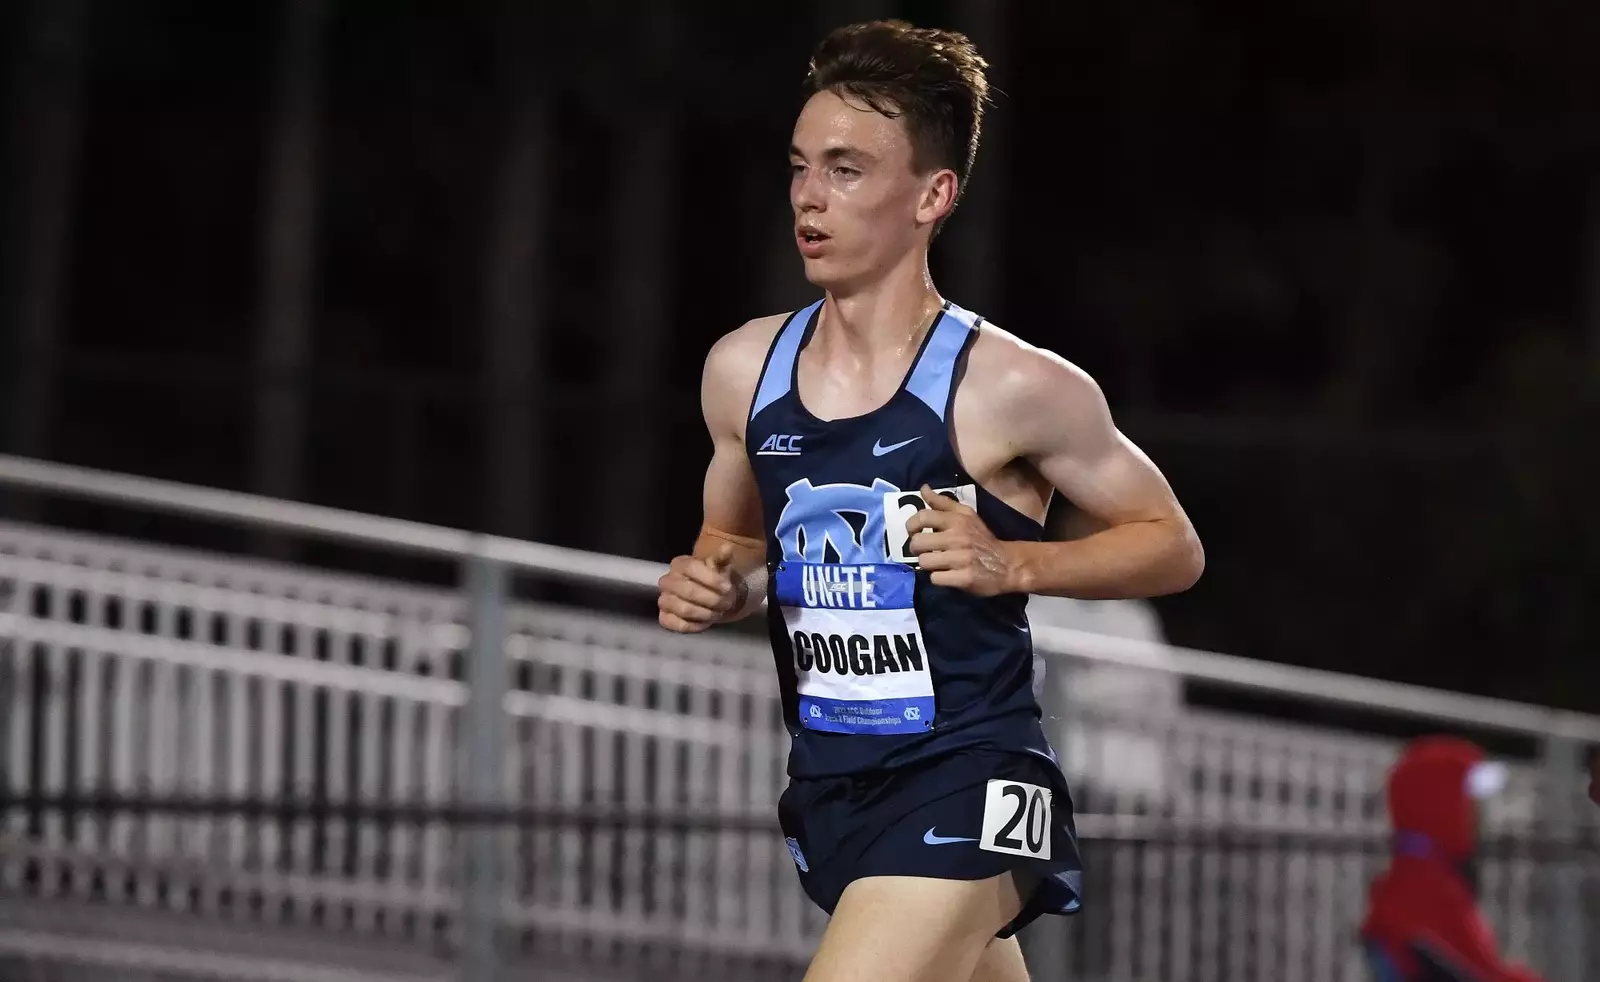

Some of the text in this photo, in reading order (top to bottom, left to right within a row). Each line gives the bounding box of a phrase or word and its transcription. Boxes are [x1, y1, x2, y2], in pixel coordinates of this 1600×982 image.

[759, 433, 804, 452] ACC
[802, 564, 876, 608] UNITE
[793, 630, 924, 676] COOGAN
[843, 714, 857, 725] Field
[857, 717, 902, 726] Championships
[993, 784, 1048, 854] 20
